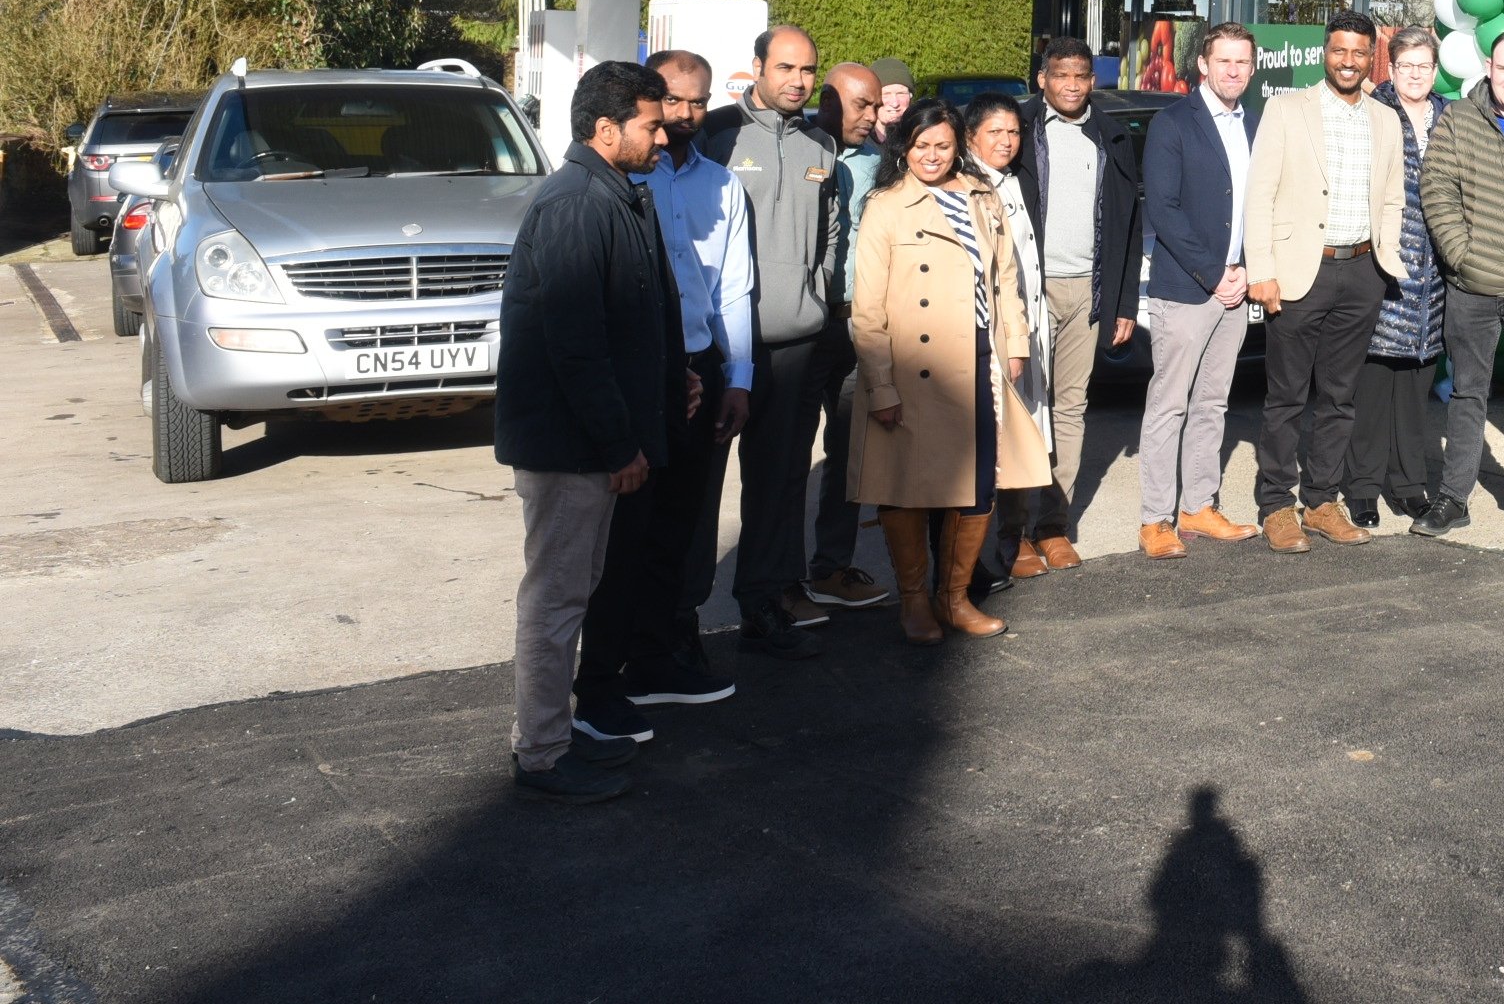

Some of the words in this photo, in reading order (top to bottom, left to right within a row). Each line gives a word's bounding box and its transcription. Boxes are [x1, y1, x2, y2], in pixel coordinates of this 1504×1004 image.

[1257, 41, 1288, 69] Proud
[1290, 45, 1302, 66] to
[1261, 80, 1274, 97] the
[356, 349, 421, 374] CN54
[430, 346, 477, 369] UYV
